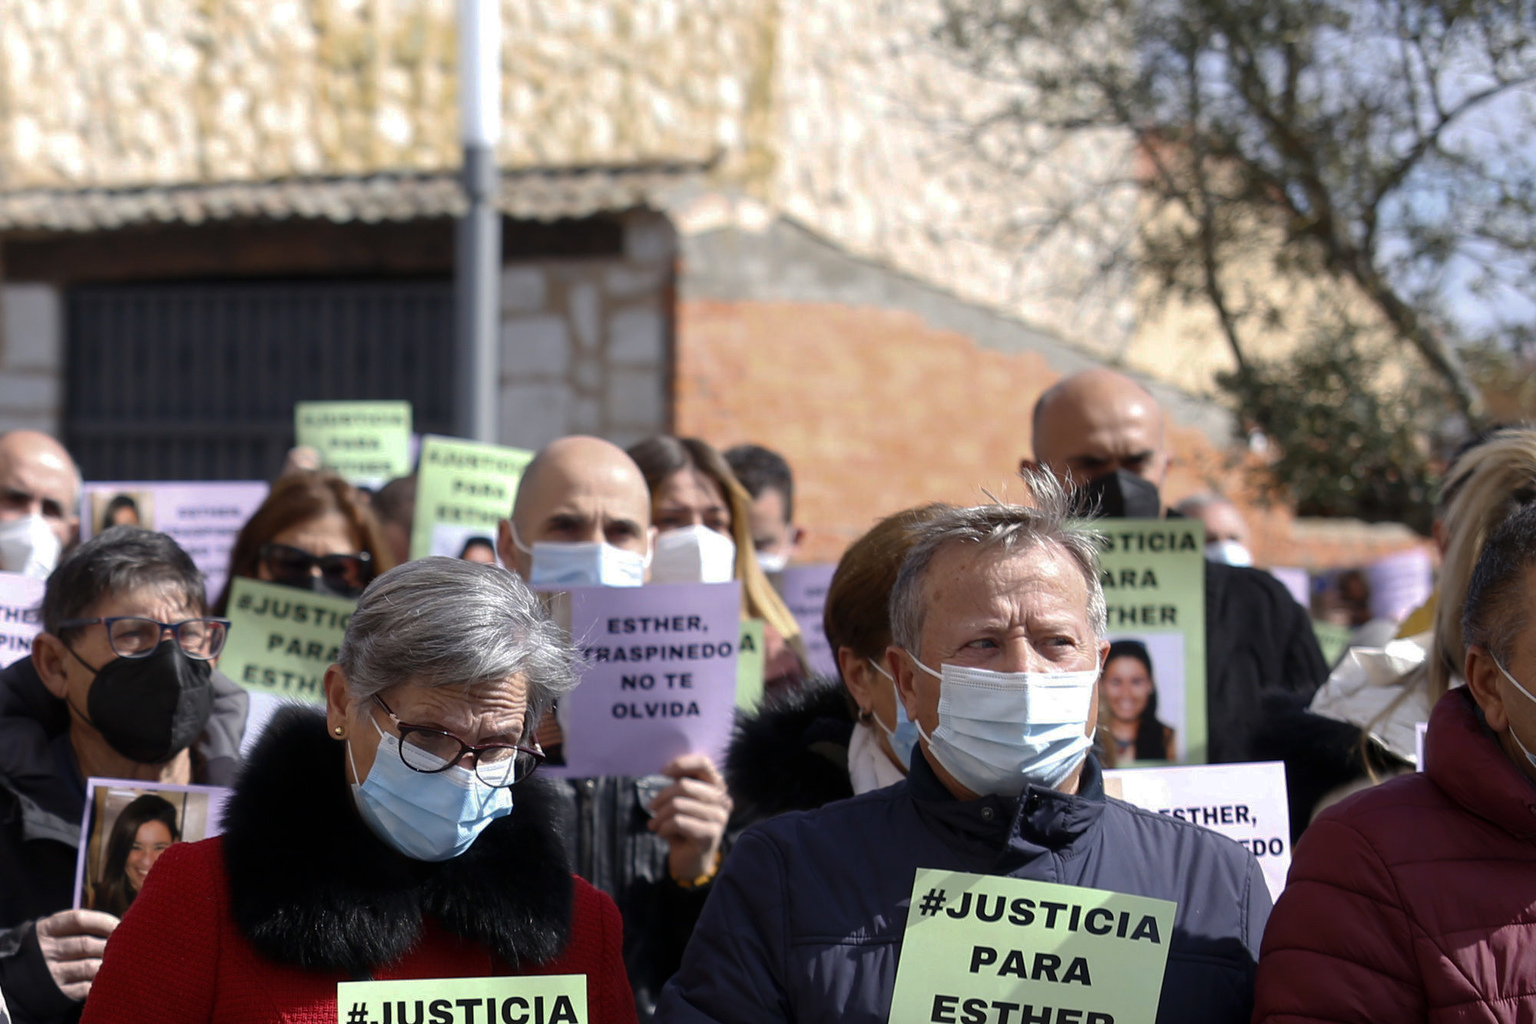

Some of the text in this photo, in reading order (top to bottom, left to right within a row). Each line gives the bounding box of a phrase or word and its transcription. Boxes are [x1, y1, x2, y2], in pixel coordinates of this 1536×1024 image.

[1101, 568, 1158, 589] ARA
[237, 593, 351, 631] #JUSTIC
[1106, 604, 1178, 626] THER
[607, 615, 709, 634] ESTHER,
[242, 664, 325, 697] ESTH
[620, 673, 694, 690] NO TE
[611, 702, 701, 719] OLVIDA
[1158, 805, 1258, 827] STHER,
[918, 888, 1162, 944] #JUSTICIA
[969, 945, 1092, 987] PARA
